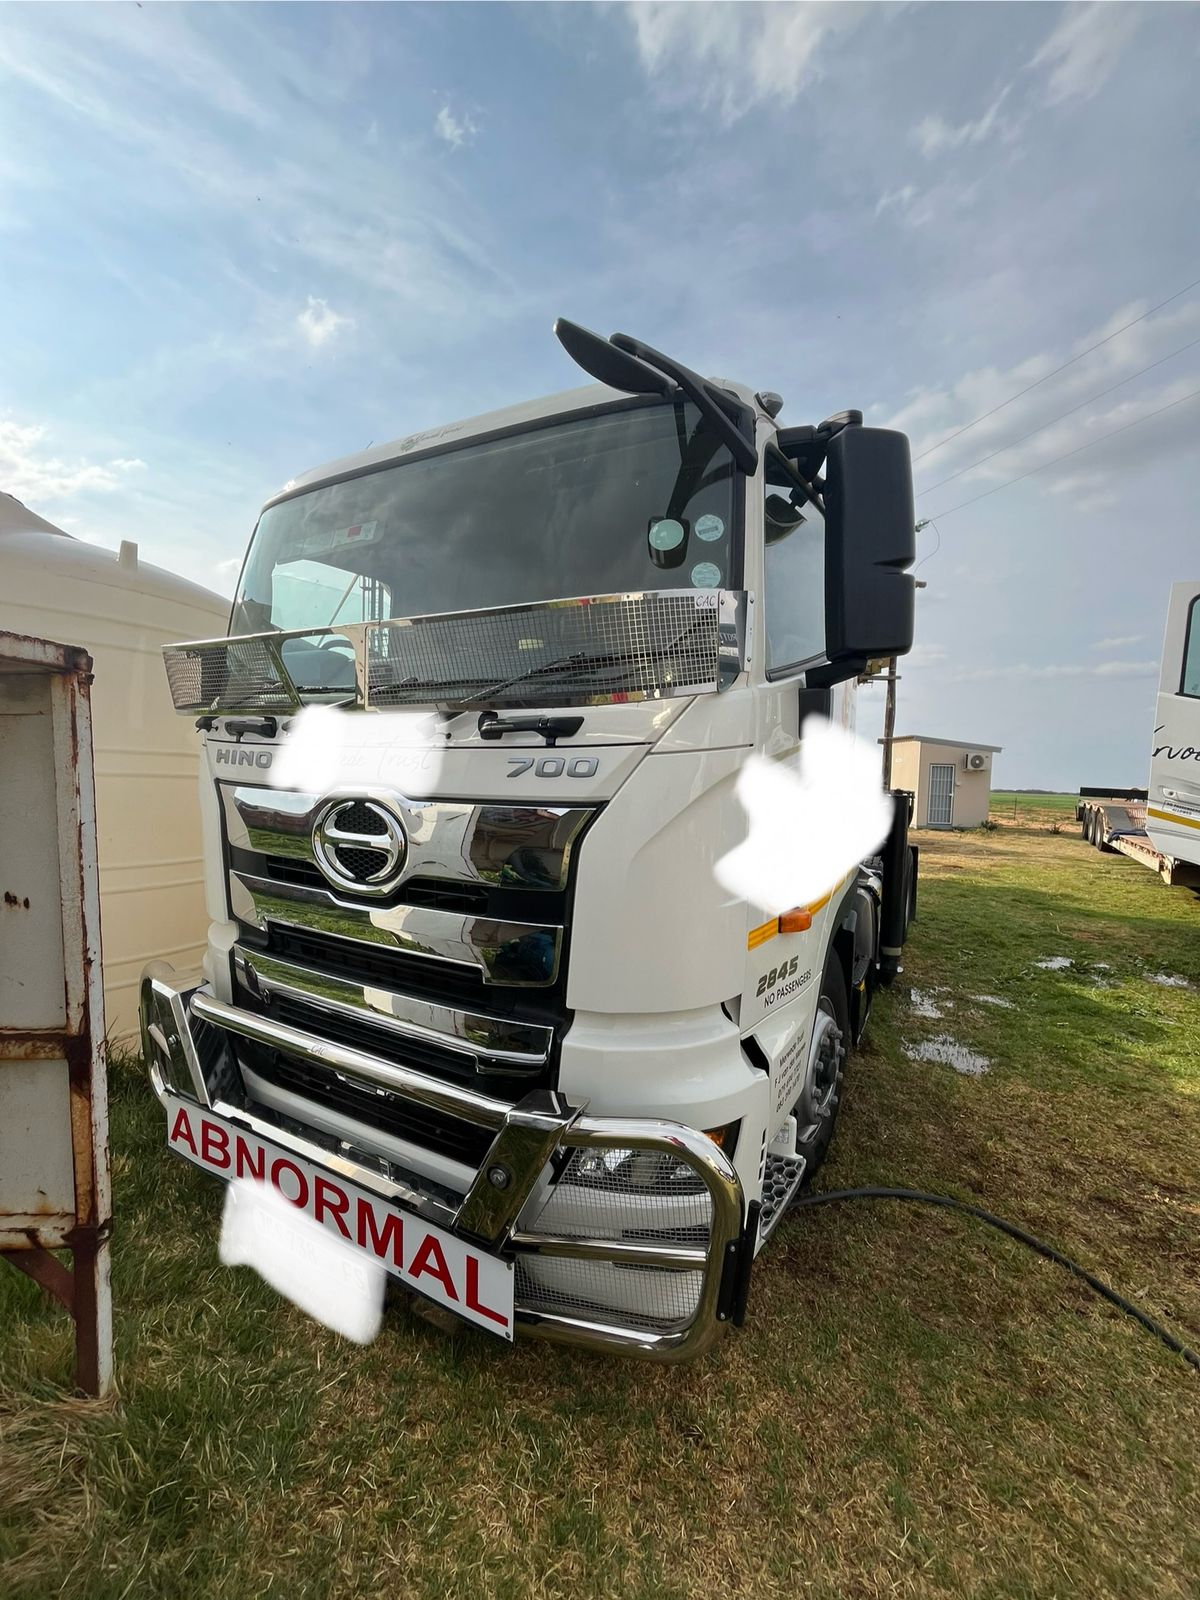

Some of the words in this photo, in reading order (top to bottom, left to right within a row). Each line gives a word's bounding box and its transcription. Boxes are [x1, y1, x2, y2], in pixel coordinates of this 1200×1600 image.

[215, 748, 273, 769] HINO
[506, 756, 600, 779] 700
[756, 955, 799, 998] 2845
[764, 993, 775, 1009] NO
[777, 969, 812, 1000] PASSENGERS
[170, 1107, 509, 1328] ABNORMAL
